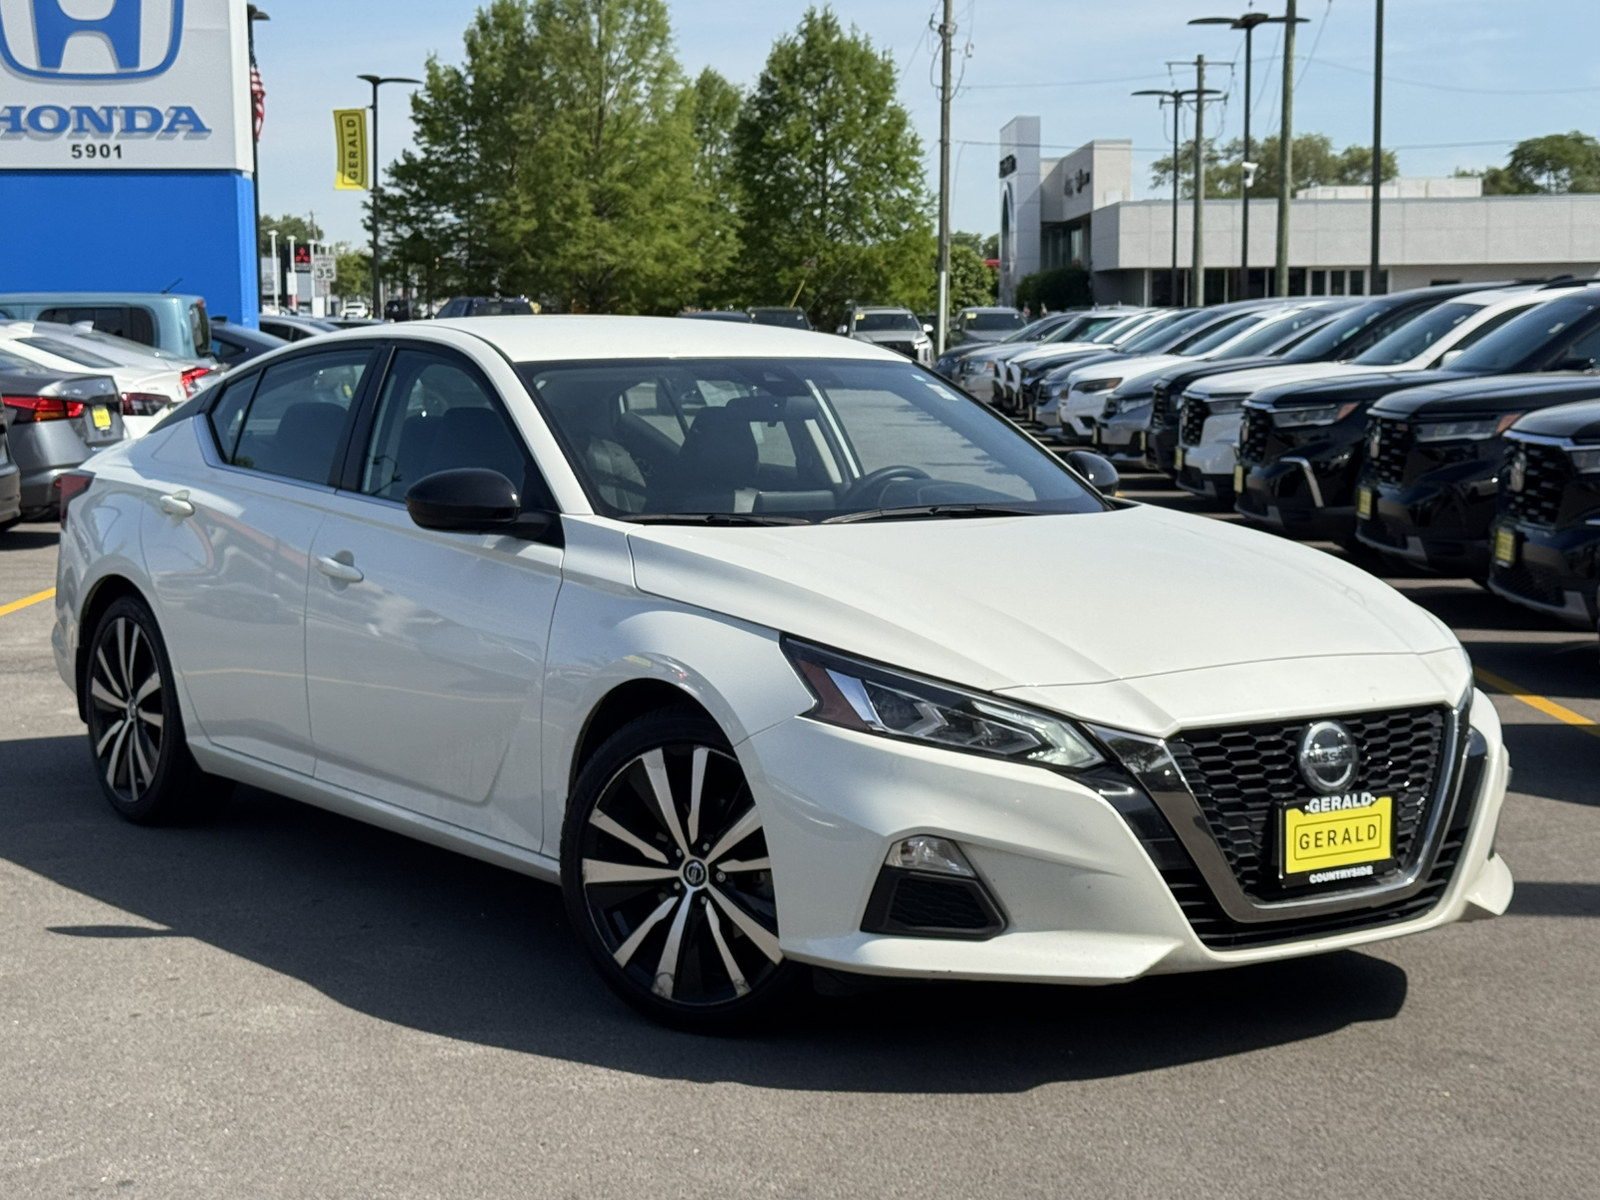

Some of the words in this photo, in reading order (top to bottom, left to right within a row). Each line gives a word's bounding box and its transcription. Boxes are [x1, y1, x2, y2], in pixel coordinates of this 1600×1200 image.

[0, 105, 212, 135] HONDA
[71, 144, 122, 159] 5901
[346, 119, 358, 180] GERALD
[316, 268, 335, 279] 35
[1309, 792, 1372, 813] GERALD
[1299, 824, 1377, 850] GERALD
[1308, 865, 1373, 884] COUNTRYSIDE
